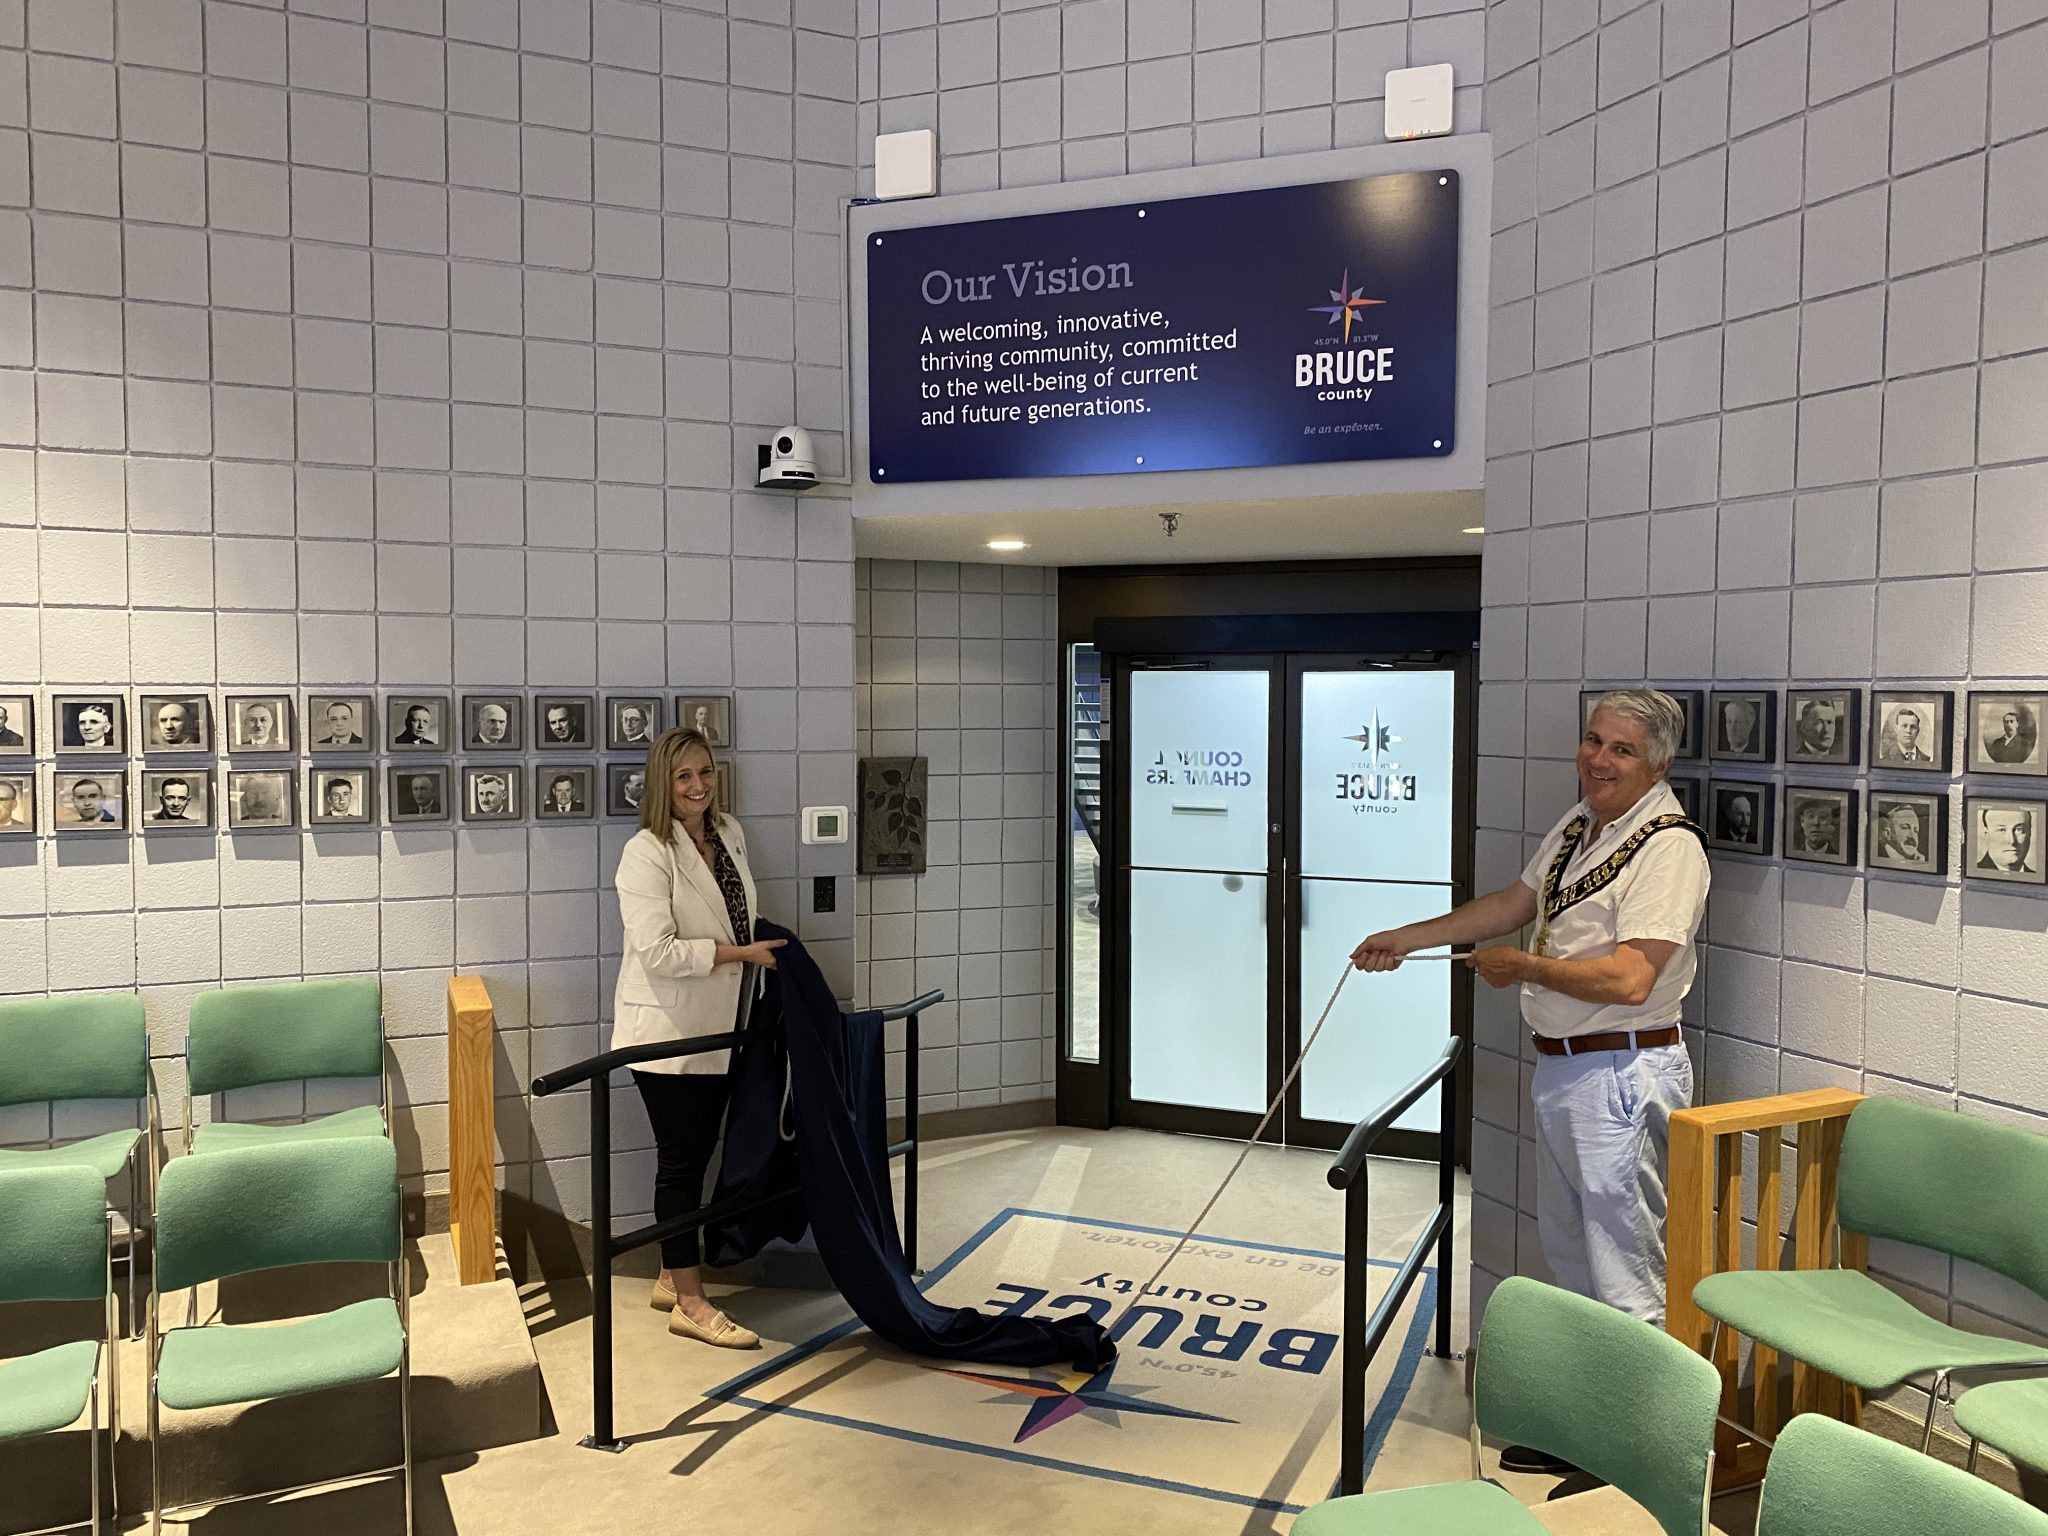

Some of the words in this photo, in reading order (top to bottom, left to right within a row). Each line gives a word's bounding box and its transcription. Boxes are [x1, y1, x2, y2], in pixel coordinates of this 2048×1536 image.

[921, 270, 996, 305] Our
[1002, 257, 1133, 297] Vision
[920, 326, 933, 345] A
[939, 319, 1048, 342] welcoming,
[1057, 308, 1170, 334] innovative,
[921, 352, 993, 372] thriving
[1000, 341, 1114, 367] community,
[1122, 328, 1238, 357] committed
[921, 381, 940, 399] to
[947, 378, 978, 397] the
[985, 371, 1087, 396] well-being
[1094, 367, 1115, 388] of
[1121, 362, 1198, 385] current
[1296, 347, 1394, 387] BRUCE
[1317, 388, 1373, 401] county
[921, 406, 954, 426] and
[961, 403, 1021, 424] future
[1028, 396, 1151, 424] generations.
[1304, 425, 1316, 435] Be
[1318, 425, 1331, 434] an
[1334, 422, 1383, 434] explorer.
[1079, 1230, 1236, 1260] explorer.
[1245, 1251, 1289, 1268] an
[1302, 1259, 1341, 1278] Be
[1080, 1272, 1268, 1313] county
[1138, 1357, 1239, 1381] 45.0°N
